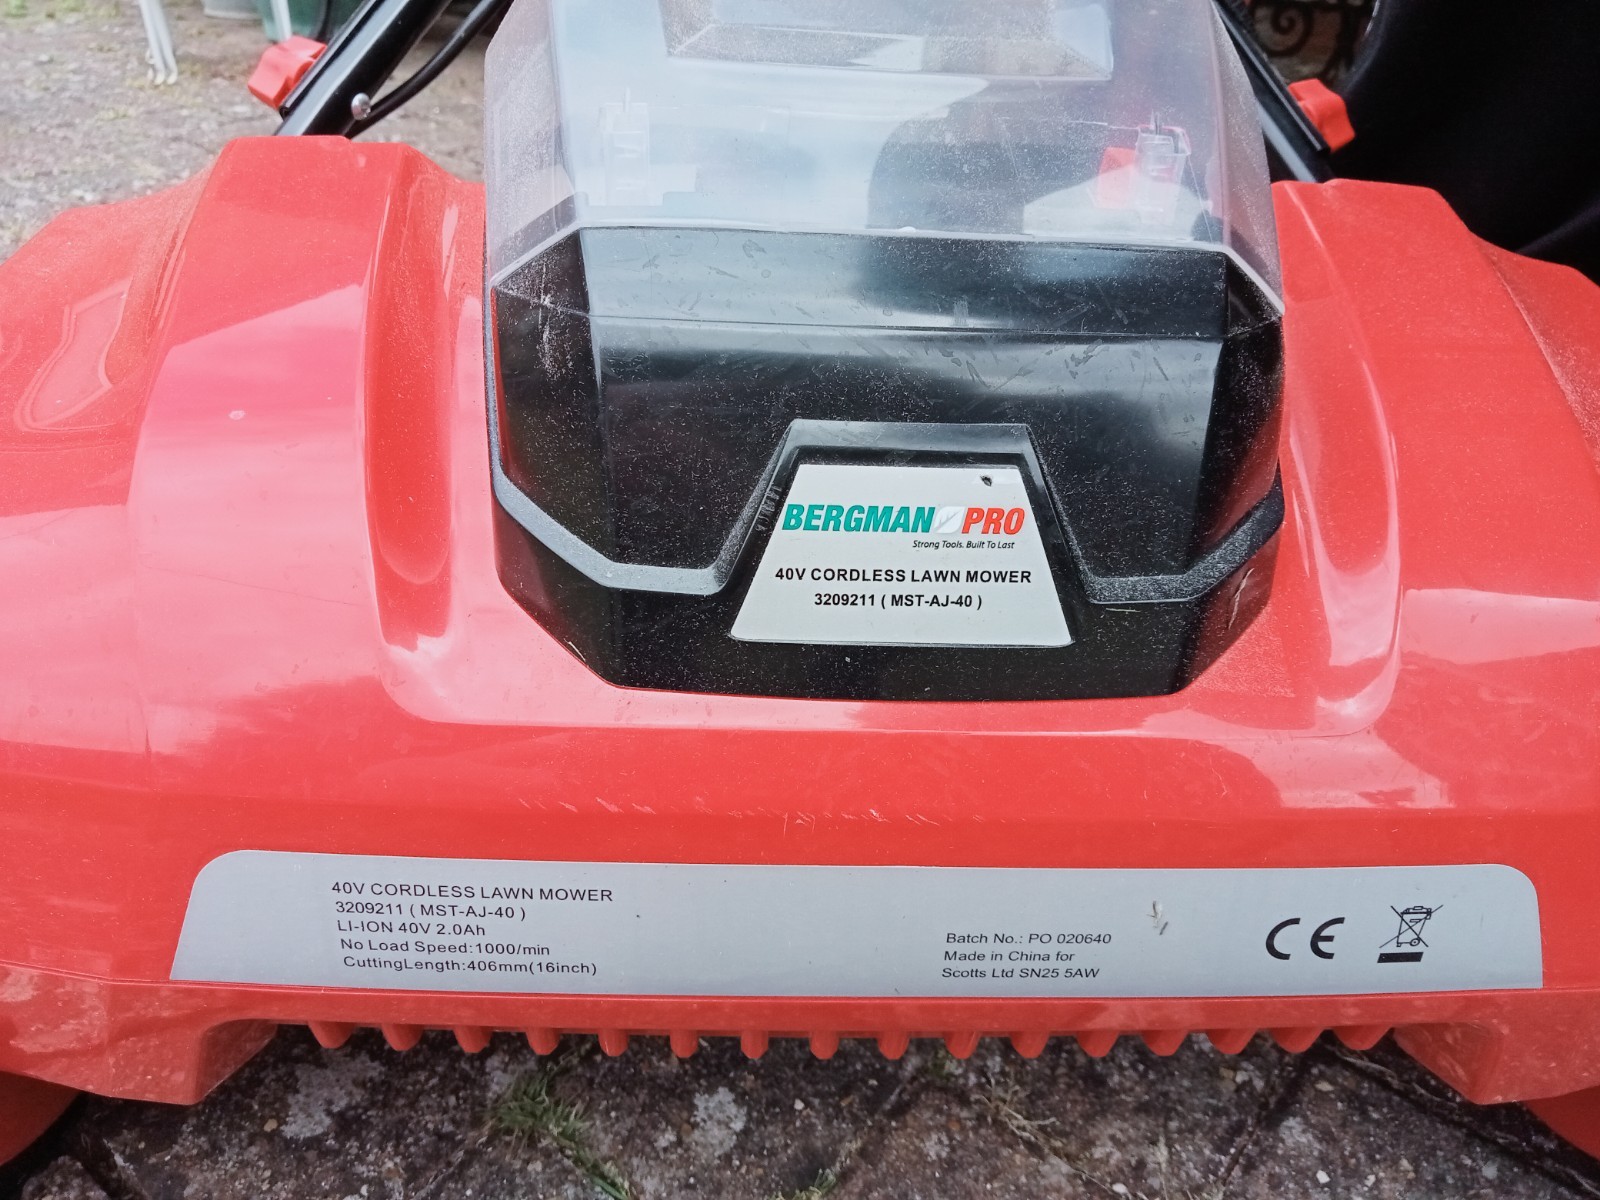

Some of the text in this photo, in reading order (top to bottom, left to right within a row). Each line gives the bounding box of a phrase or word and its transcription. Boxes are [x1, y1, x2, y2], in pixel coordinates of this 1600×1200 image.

[782, 504, 1025, 535] BERGMAN PRO
[912, 540, 940, 550] Strong
[942, 540, 964, 548] Tools.
[987, 541, 996, 549] To
[998, 541, 1015, 549] Last
[775, 568, 1031, 583] 40V CORDLESS LAWN MOWER
[814, 593, 874, 606] 3209211
[891, 594, 972, 607] MST-AJ-40
[332, 882, 613, 901] 40V CORDLESS LAWN MOWER
[336, 901, 402, 915] 3209211
[421, 904, 514, 918] MST-AJ-40
[337, 920, 485, 935] LI-ION 40V 2.0Ah
[341, 939, 363, 950] No
[368, 940, 409, 951] Load
[947, 933, 1111, 944] Batch No.: PO 020640
[1266, 917, 1345, 960] CE
[944, 951, 1075, 961] Made in China for
[942, 968, 1099, 978] Scotts Ltd SN25 5AW
